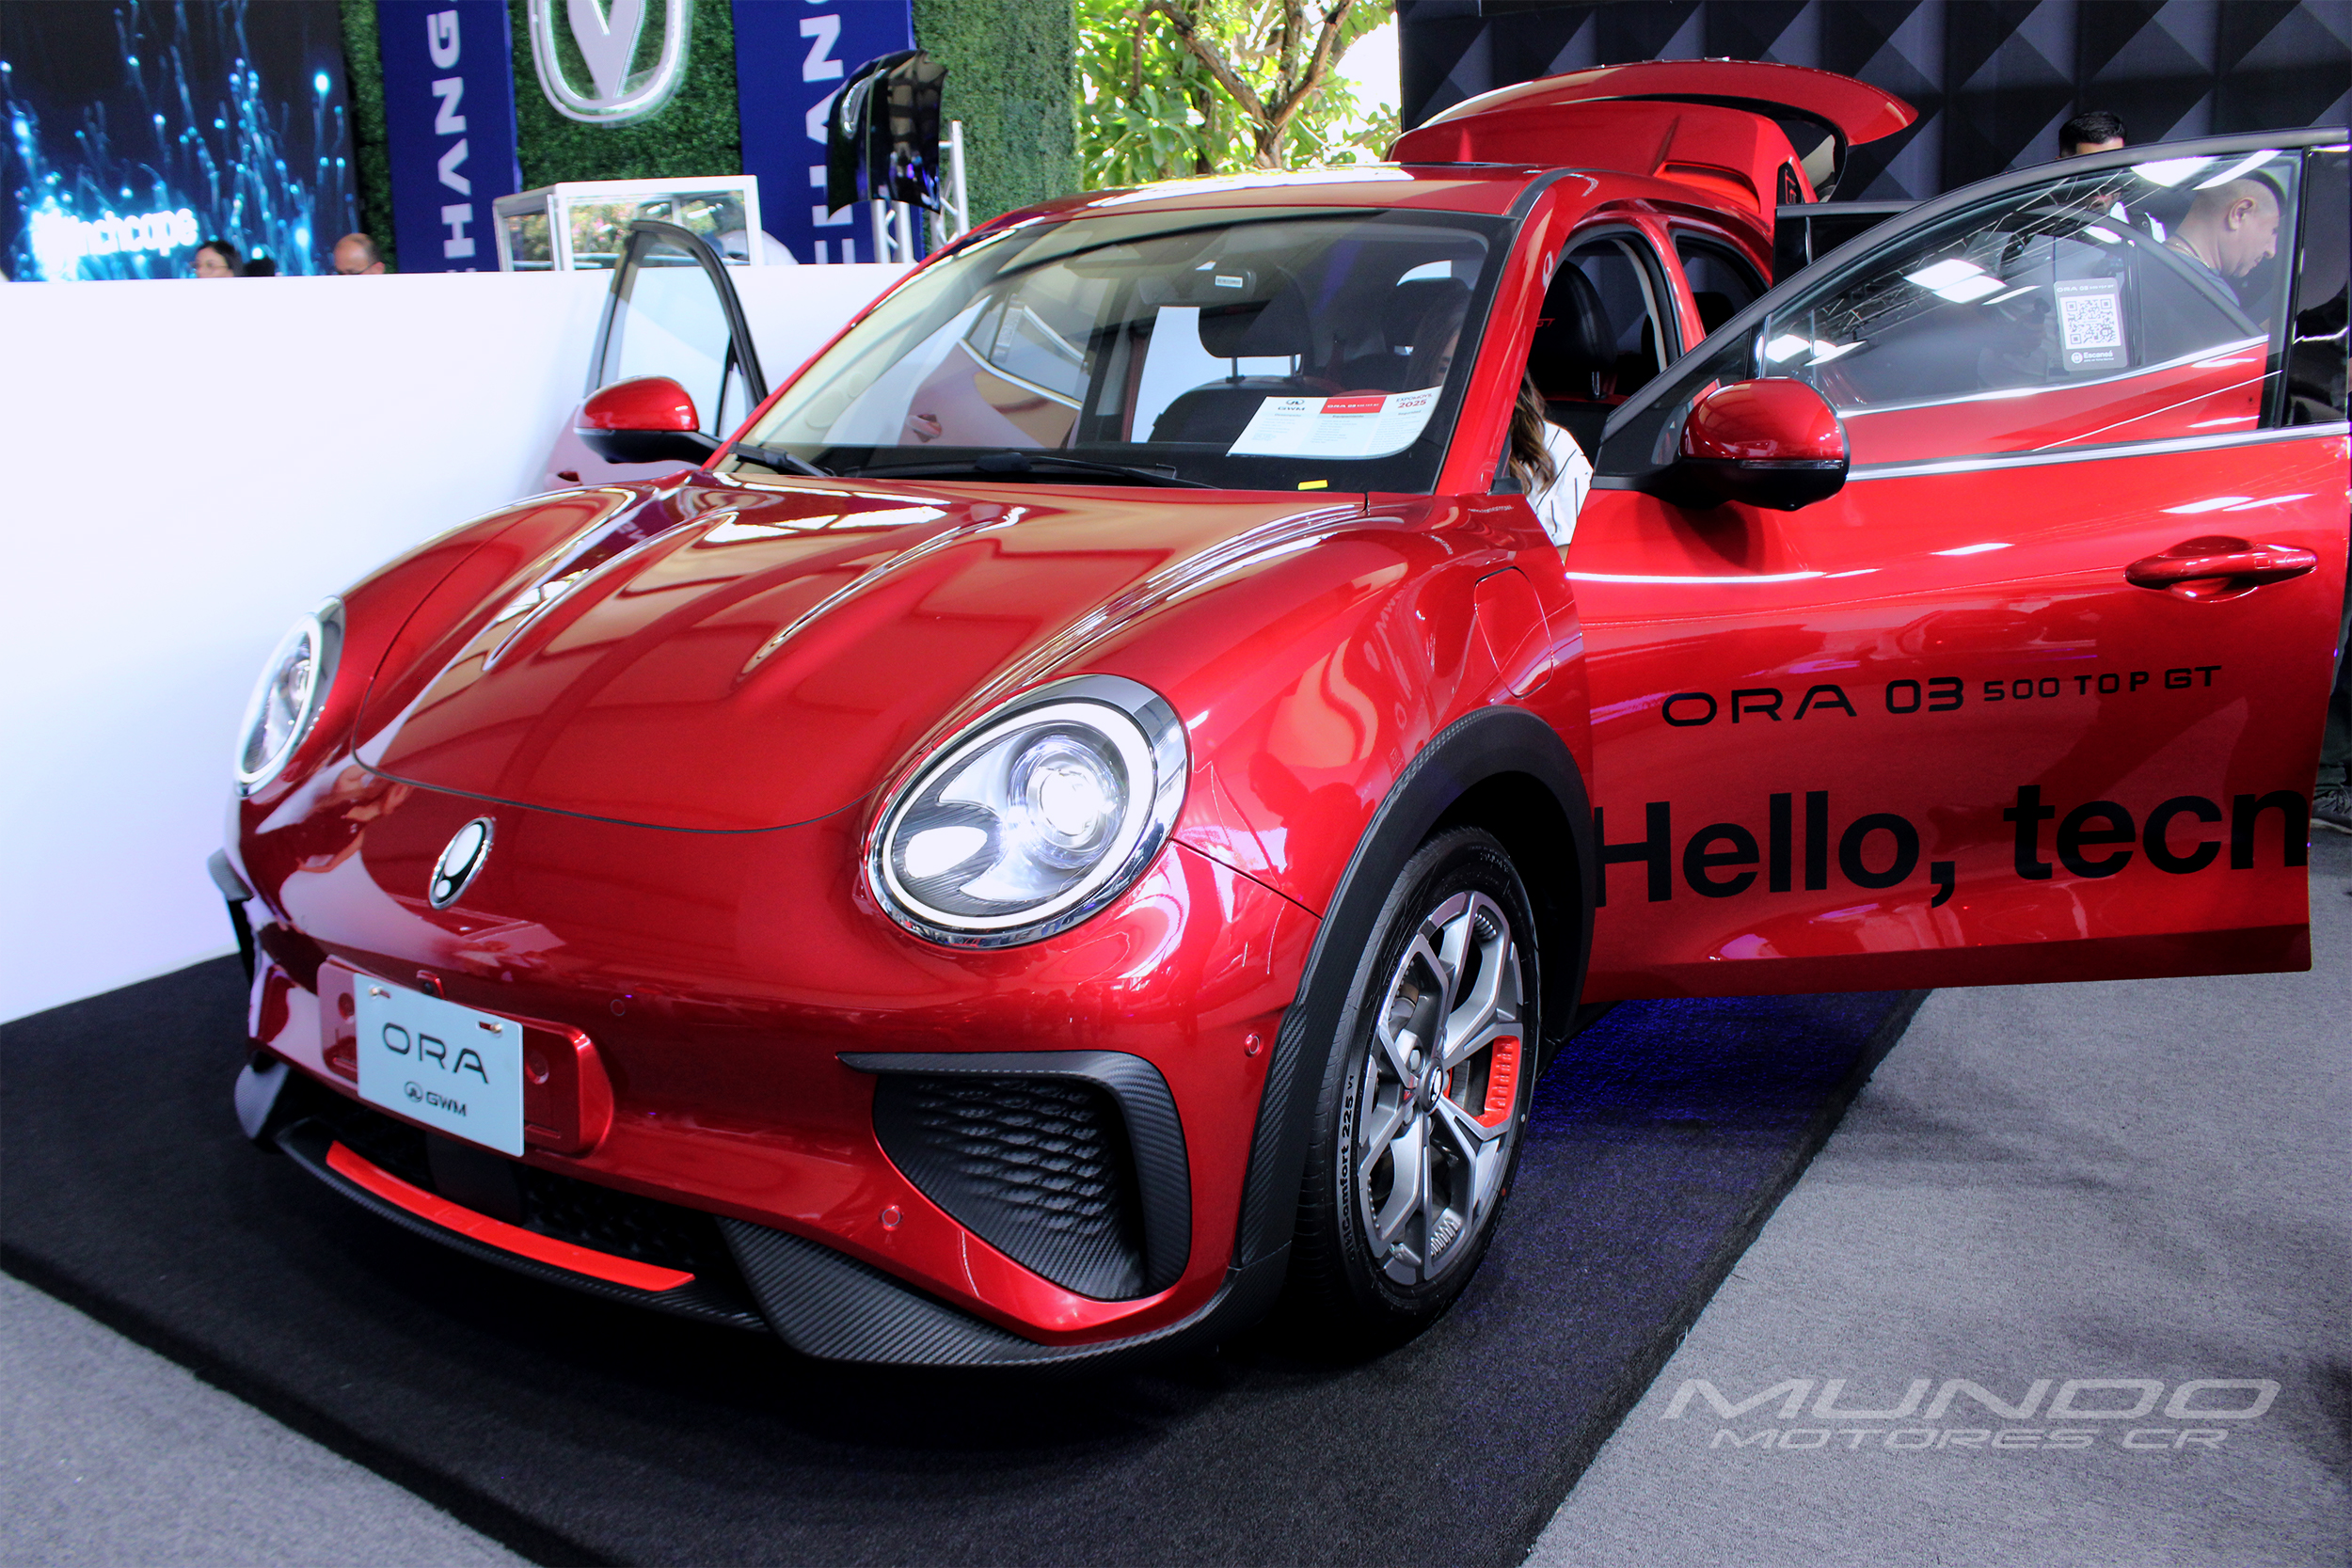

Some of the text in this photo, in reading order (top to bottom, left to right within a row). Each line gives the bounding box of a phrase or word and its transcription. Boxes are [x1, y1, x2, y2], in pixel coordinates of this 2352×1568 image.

[1398, 399, 1427, 408] 2025
[1661, 664, 2222, 727] ORA 03 500 TOP GT
[1594, 784, 2309, 909] Hello, tecn
[382, 1022, 489, 1085] ORA
[426, 1091, 467, 1117] GWM
[1342, 1095, 1355, 1138] 225
